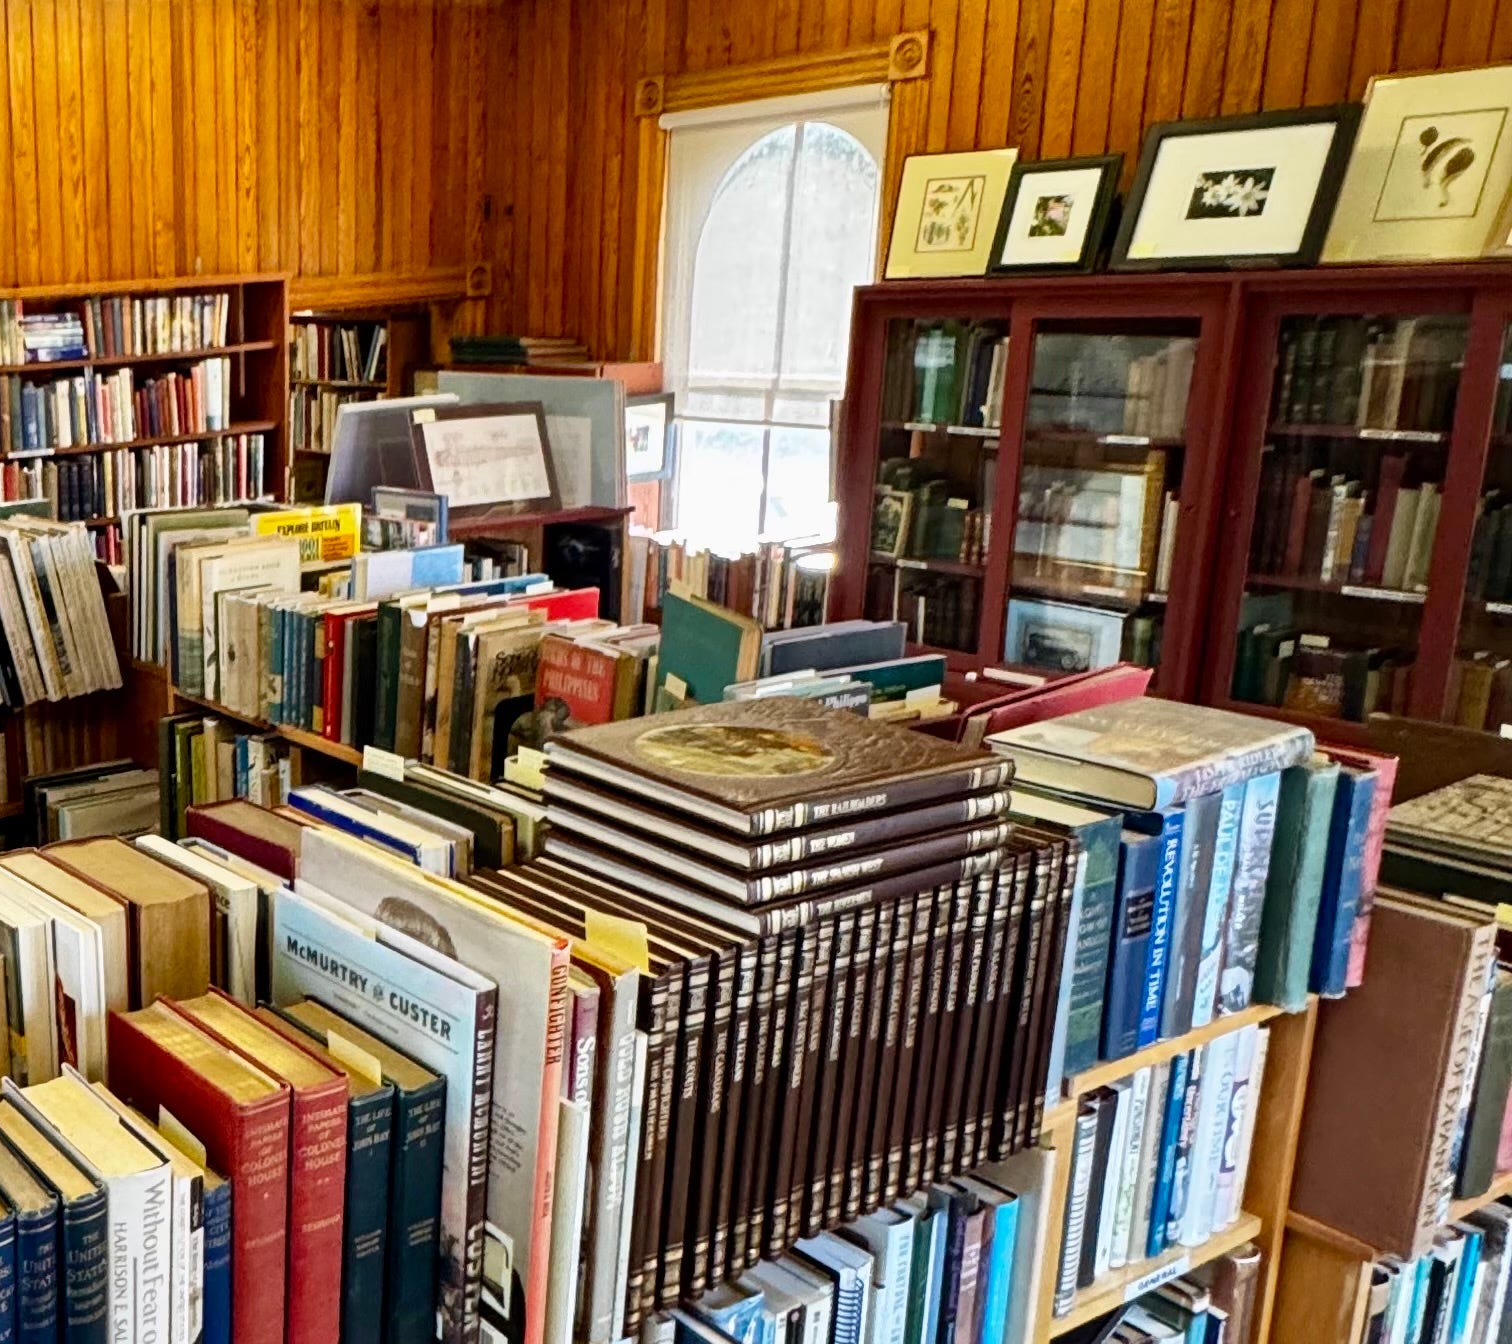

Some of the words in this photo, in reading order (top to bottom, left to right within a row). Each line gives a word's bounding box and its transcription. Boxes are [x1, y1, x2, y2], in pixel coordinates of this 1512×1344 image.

[1156, 837, 1180, 947] REVOLUTION
[286, 934, 368, 994] McMURTRY
[389, 991, 452, 1042] CUSTER
[545, 963, 568, 1067] GUNFIGHTER
[1145, 969, 1164, 1012] TIME
[304, 1151, 342, 1172] HOUSE
[113, 1221, 128, 1298] HARRISON
[144, 1178, 166, 1273] Without
[143, 1273, 165, 1328] Fear
